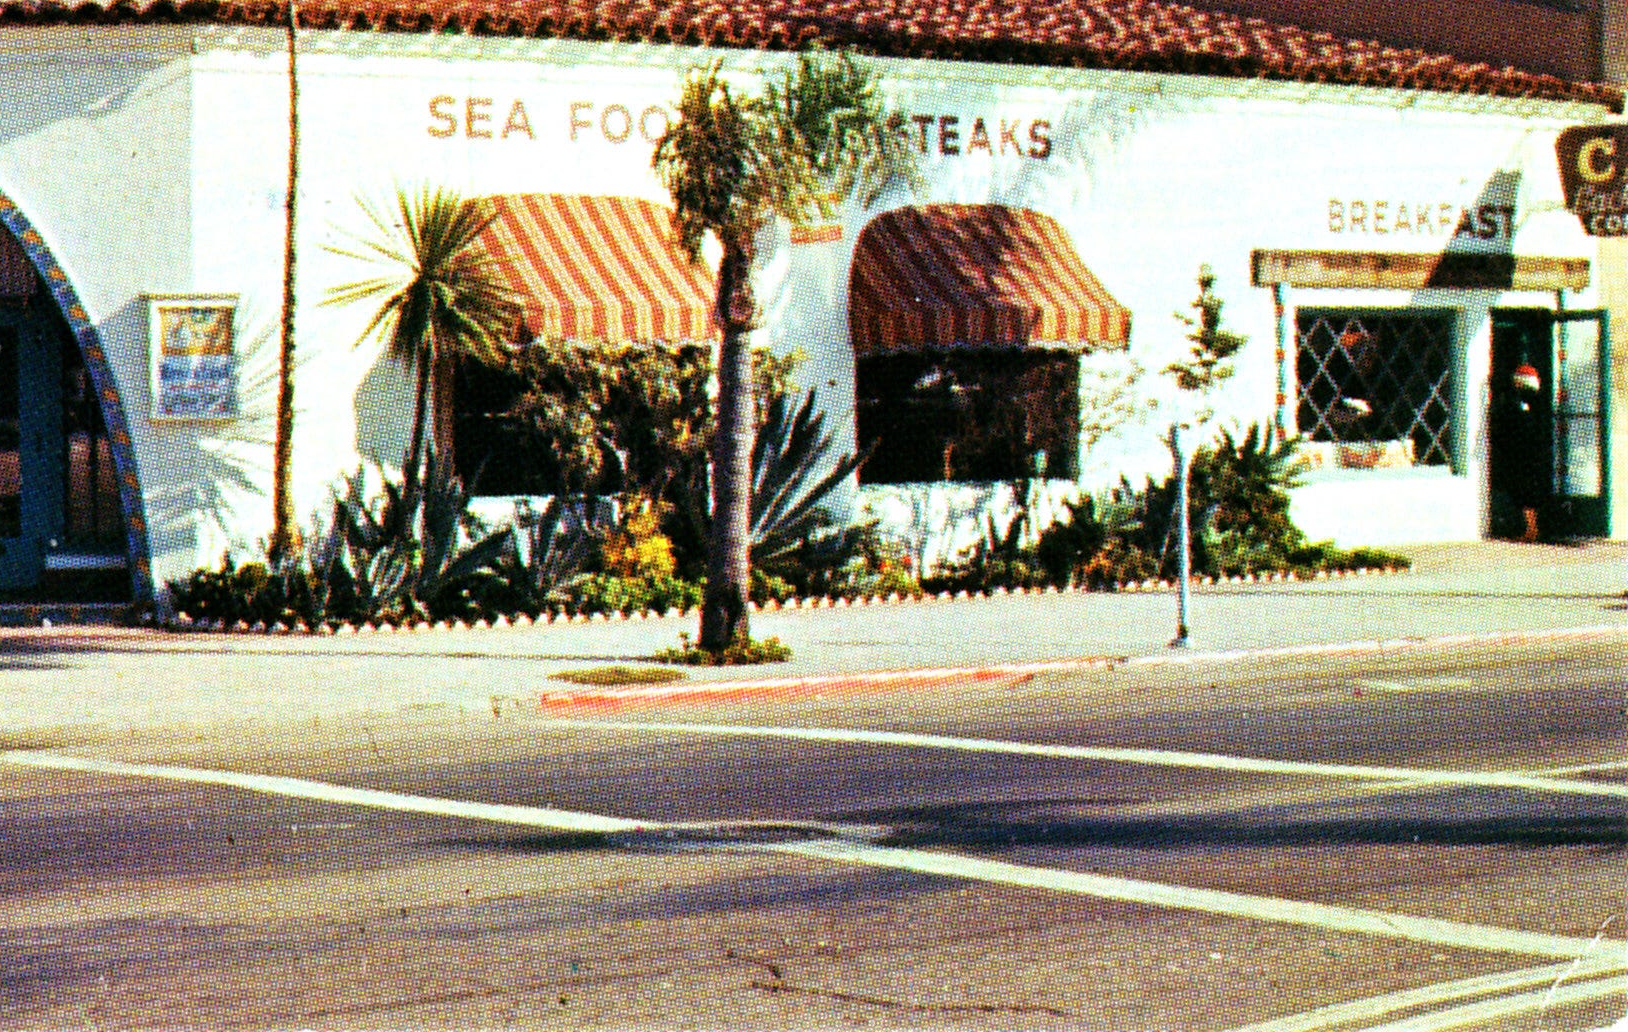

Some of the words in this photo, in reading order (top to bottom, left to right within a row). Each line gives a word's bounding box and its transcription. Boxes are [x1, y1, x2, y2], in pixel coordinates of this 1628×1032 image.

[427, 95, 535, 141] SEA
[569, 100, 670, 145] FOO
[1327, 196, 1516, 240] BREAKFAST
[1589, 213, 1628, 234] CO
